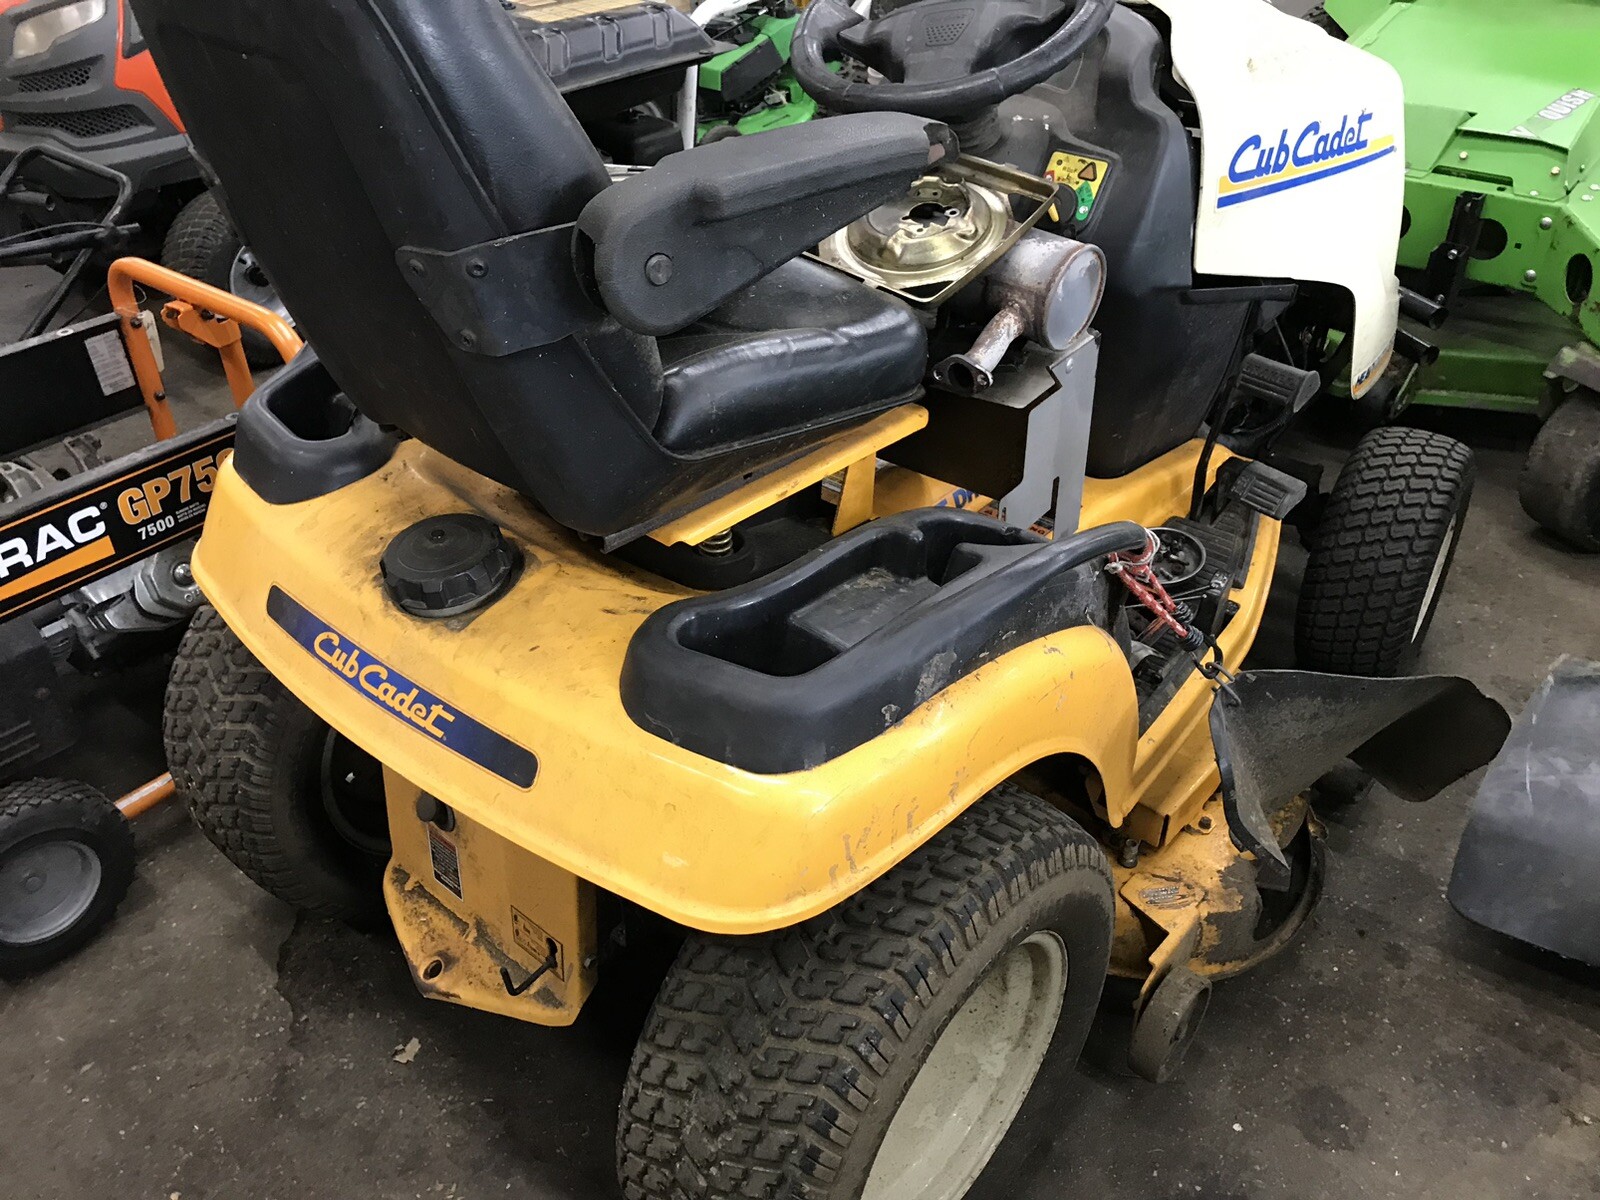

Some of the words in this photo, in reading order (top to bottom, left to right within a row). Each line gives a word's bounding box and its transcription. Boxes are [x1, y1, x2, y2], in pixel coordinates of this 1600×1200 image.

[1228, 129, 1290, 183] Cub
[1292, 112, 1374, 167] Cadet
[137, 514, 175, 541] 7500
[313, 631, 361, 679] Cub
[358, 664, 456, 739] Cadet
